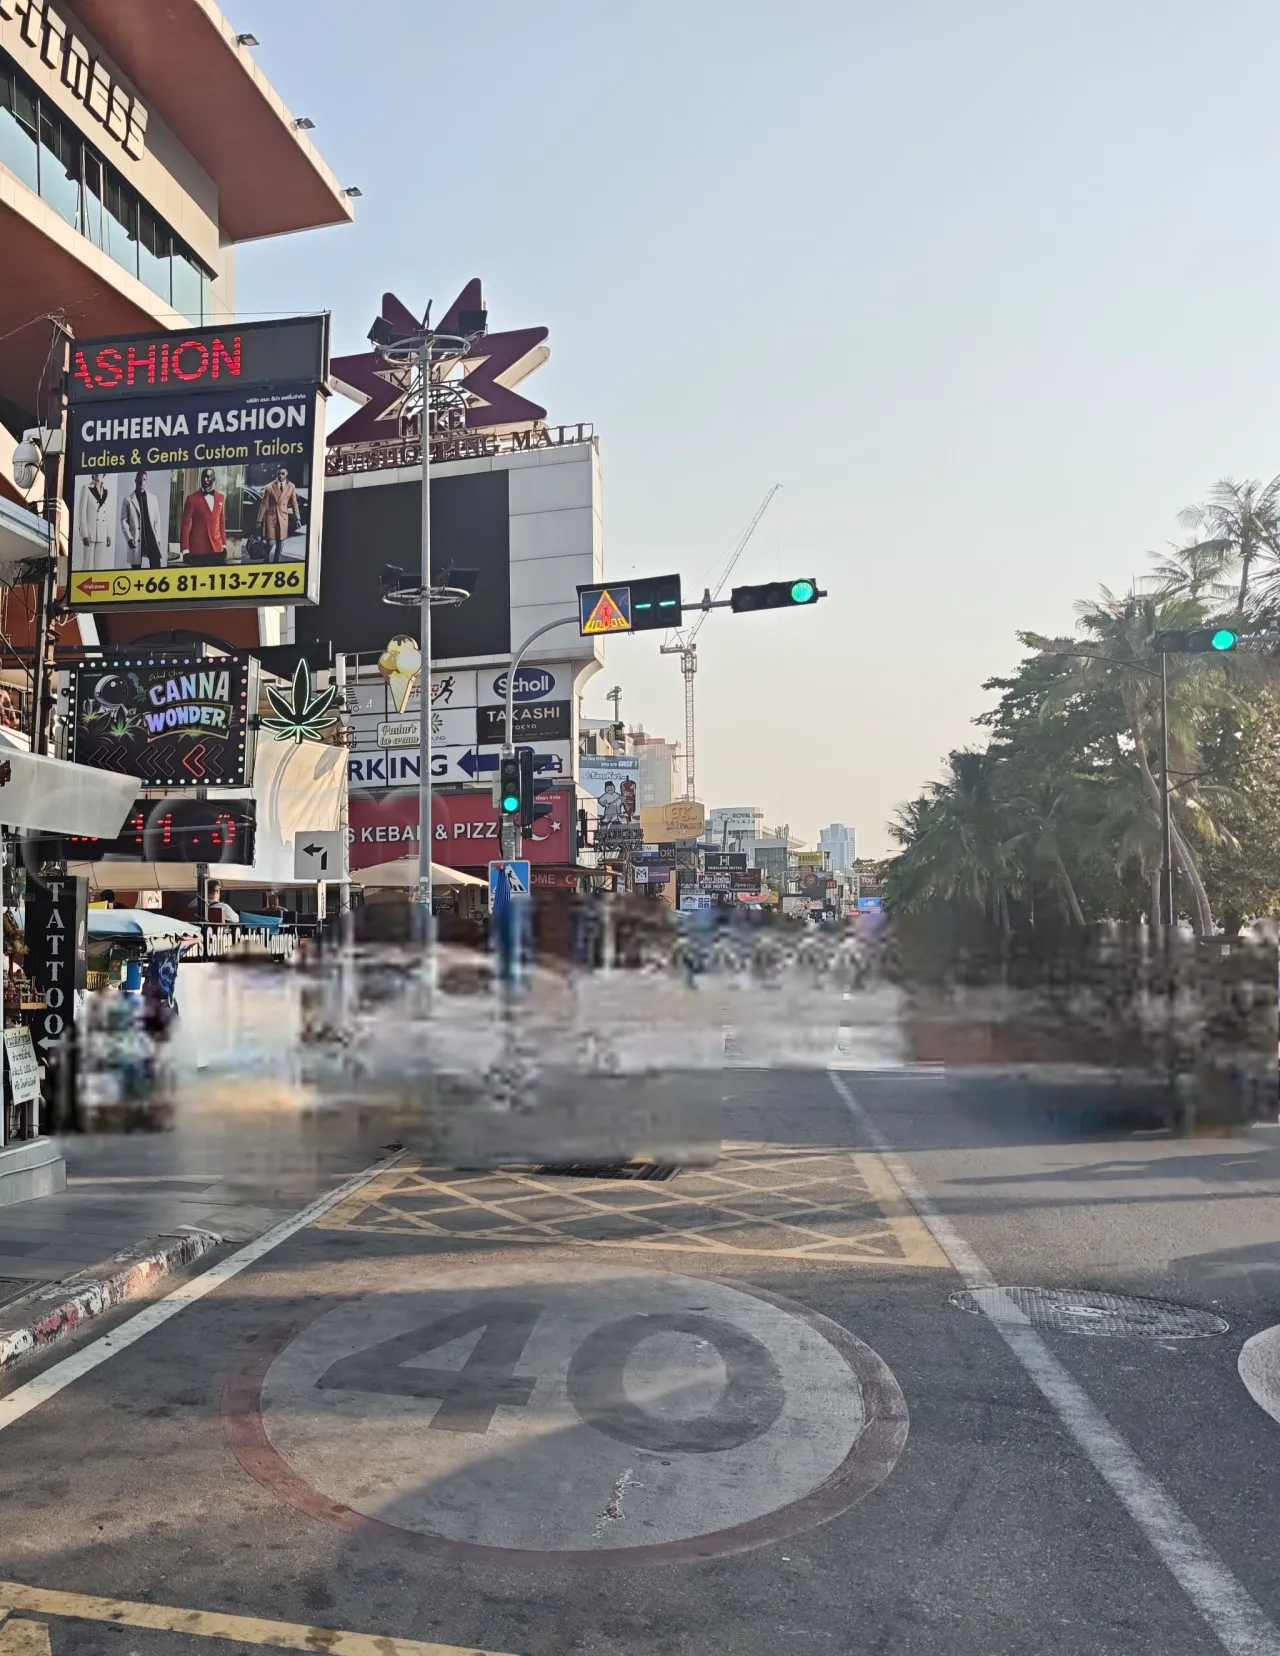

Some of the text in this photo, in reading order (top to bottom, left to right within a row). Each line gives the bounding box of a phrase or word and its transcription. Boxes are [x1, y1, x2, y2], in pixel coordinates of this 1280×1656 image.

[74, 336, 241, 389] ASHION
[81, 404, 306, 442] CHHEENA FASHION
[400, 409, 467, 437] MKE
[509, 422, 594, 451] MALL
[81, 438, 304, 468] Ladies & Gents Custom Tailors
[134, 570, 300, 593] +66 81-113-7786
[149, 671, 230, 706] CANNA
[498, 674, 549, 696] Scholl
[487, 706, 561, 723] TAKASHI
[512, 723, 537, 731] OKYO
[348, 753, 448, 786] RKING
[361, 824, 421, 843] KEBA
[435, 823, 448, 840] &
[206, 926, 233, 957] Coffee
[43, 880, 66, 1036] TATTOO
[314, 1302, 786, 1454] 40
